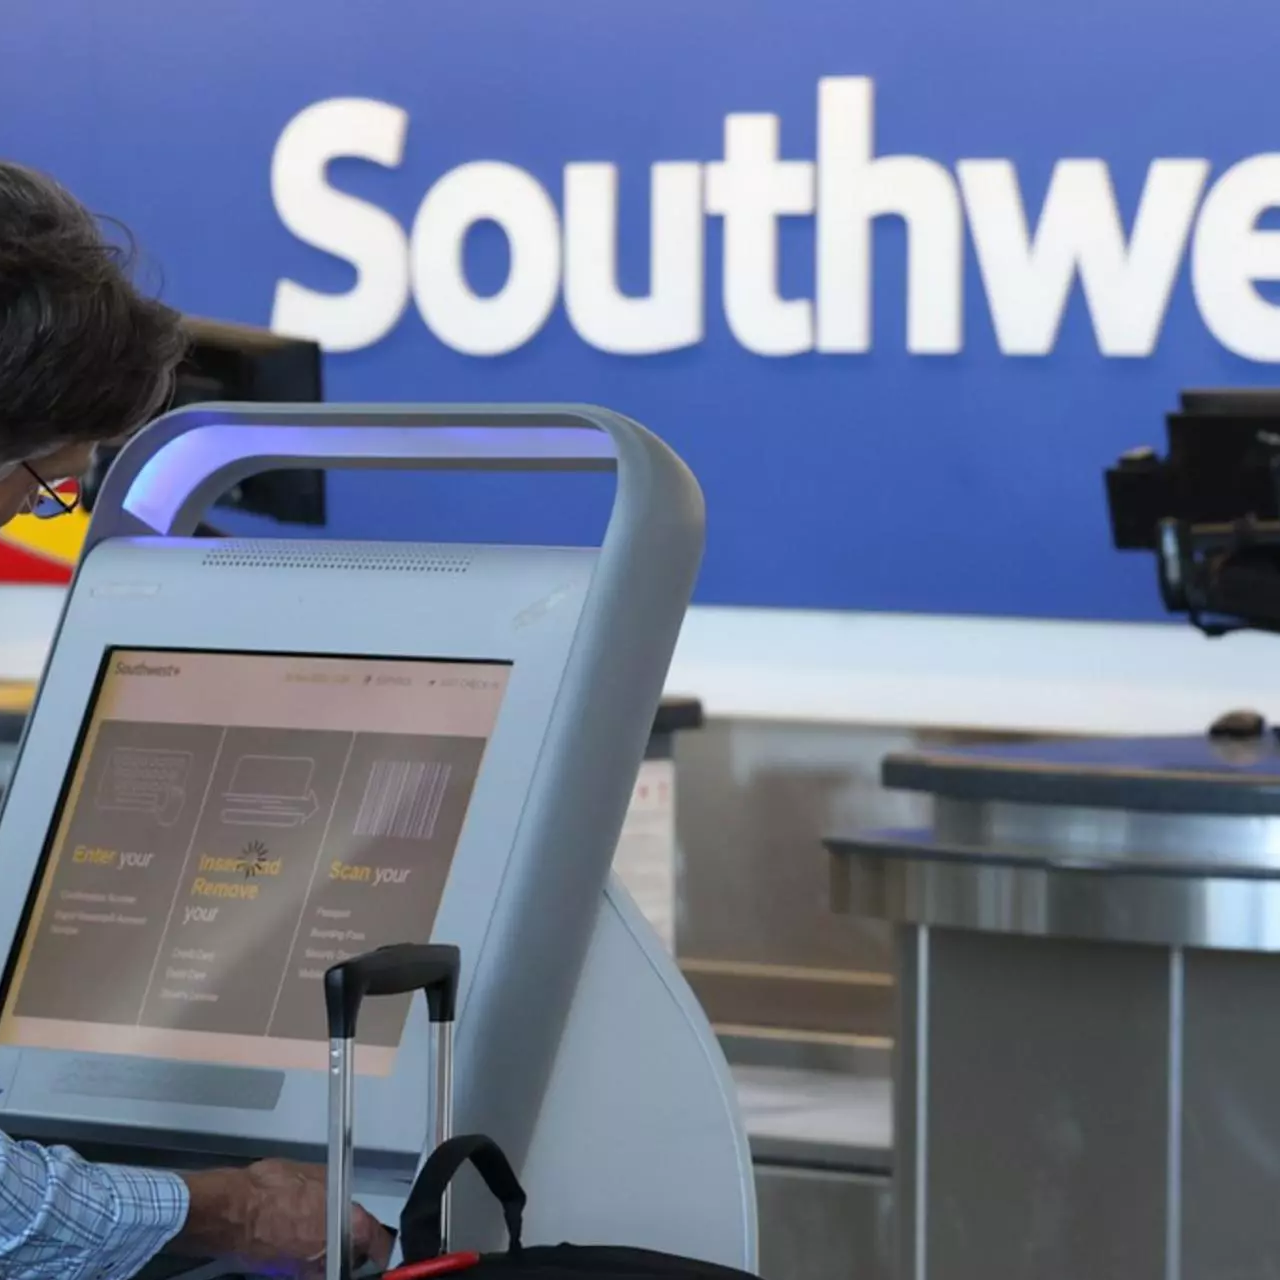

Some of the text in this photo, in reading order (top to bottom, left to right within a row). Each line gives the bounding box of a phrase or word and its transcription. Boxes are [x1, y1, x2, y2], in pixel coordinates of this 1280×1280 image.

[73, 845, 155, 870] Enter your
[329, 859, 411, 886] Scan your
[191, 877, 260, 899] Remove
[183, 905, 219, 925] your
